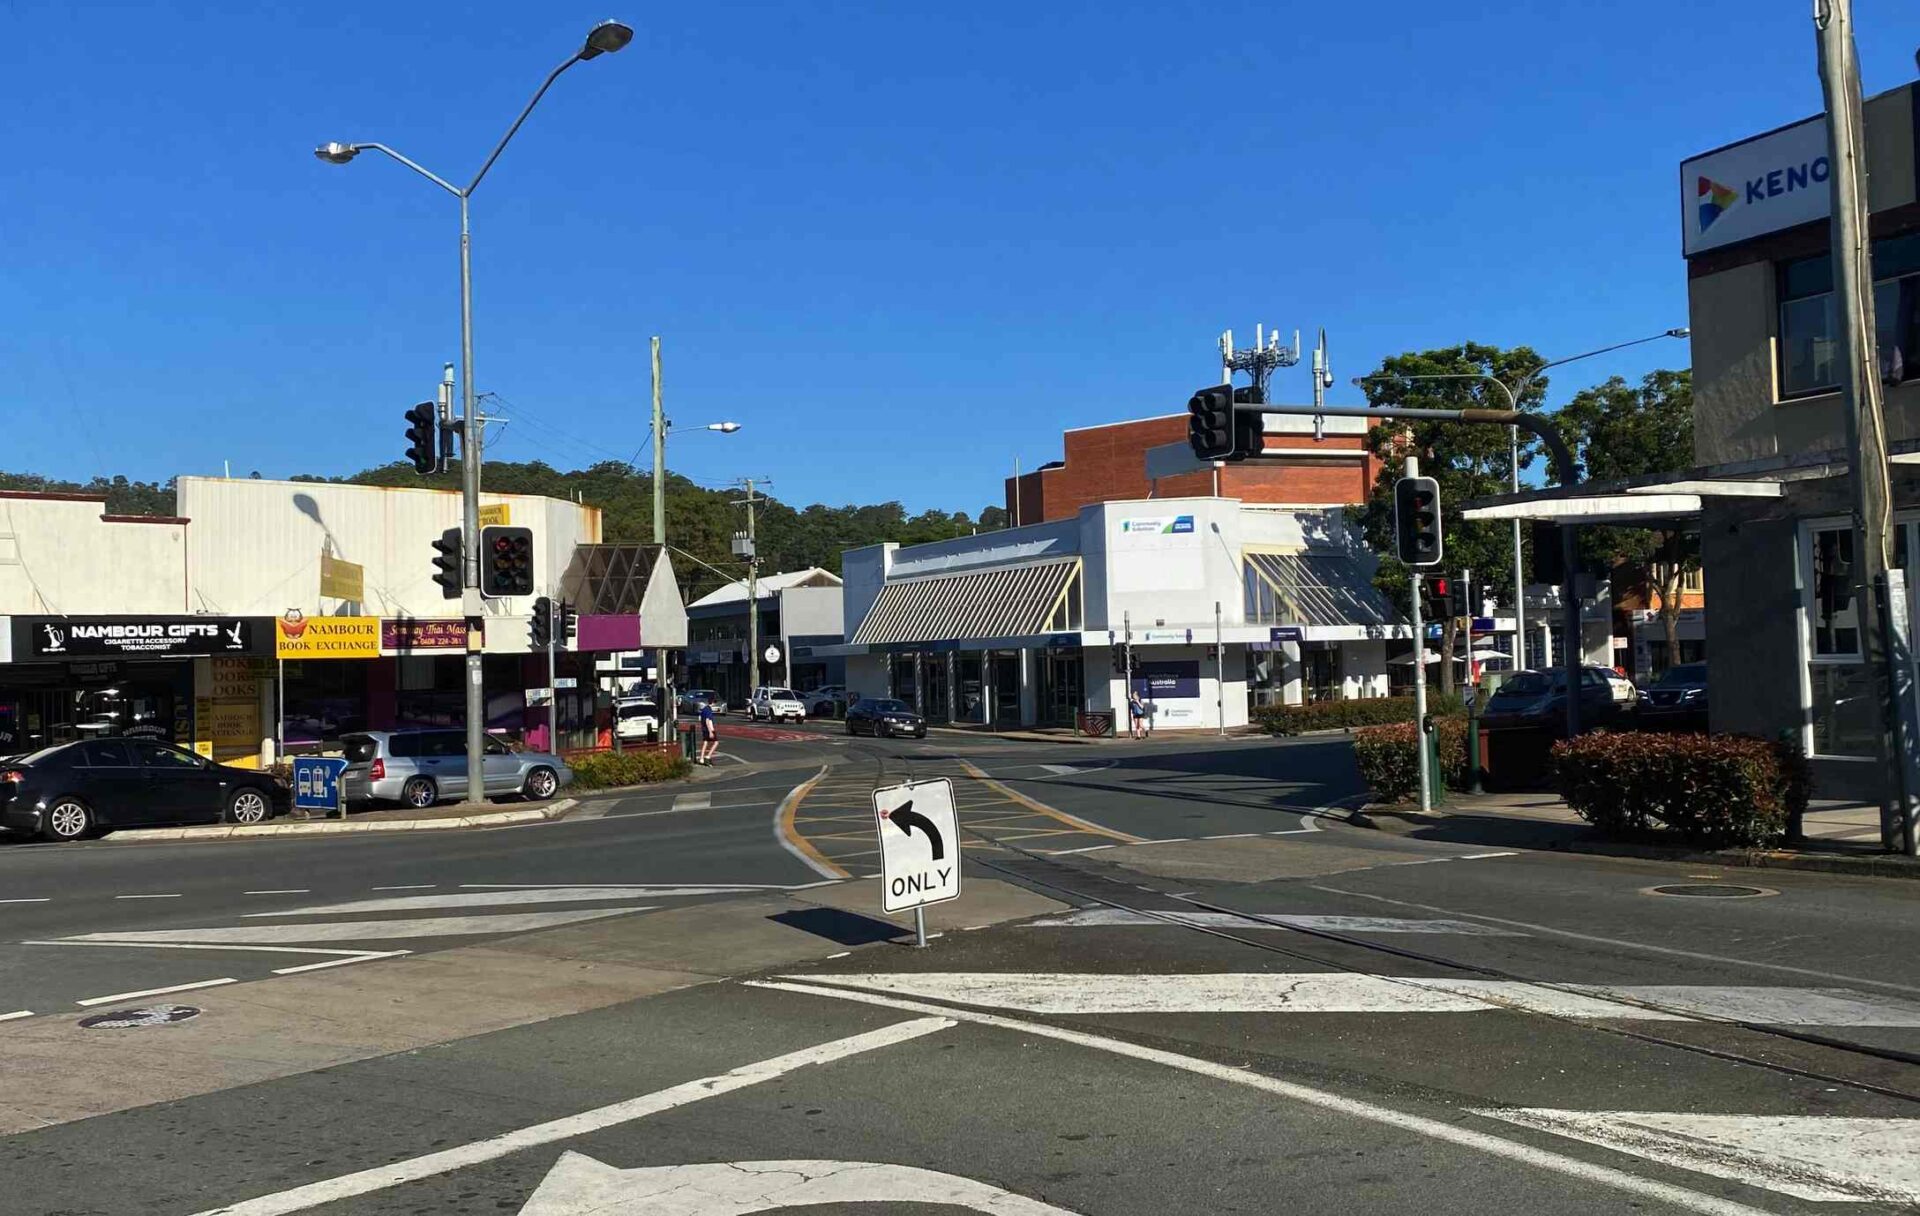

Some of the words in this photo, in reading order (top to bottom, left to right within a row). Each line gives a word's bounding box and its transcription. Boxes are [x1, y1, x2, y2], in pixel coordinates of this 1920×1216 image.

[1746, 156, 1829, 204] KENO
[71, 625, 164, 638] NAMBOUR
[168, 625, 219, 637] GIFTS
[309, 624, 374, 635] NAMBOUR
[426, 623, 443, 634] Thai
[447, 623, 467, 634] Mass
[280, 642, 311, 650] BOOK
[316, 641, 377, 650] EXCHANGE
[214, 684, 256, 695] OOKS
[891, 867, 951, 896] ONLY
